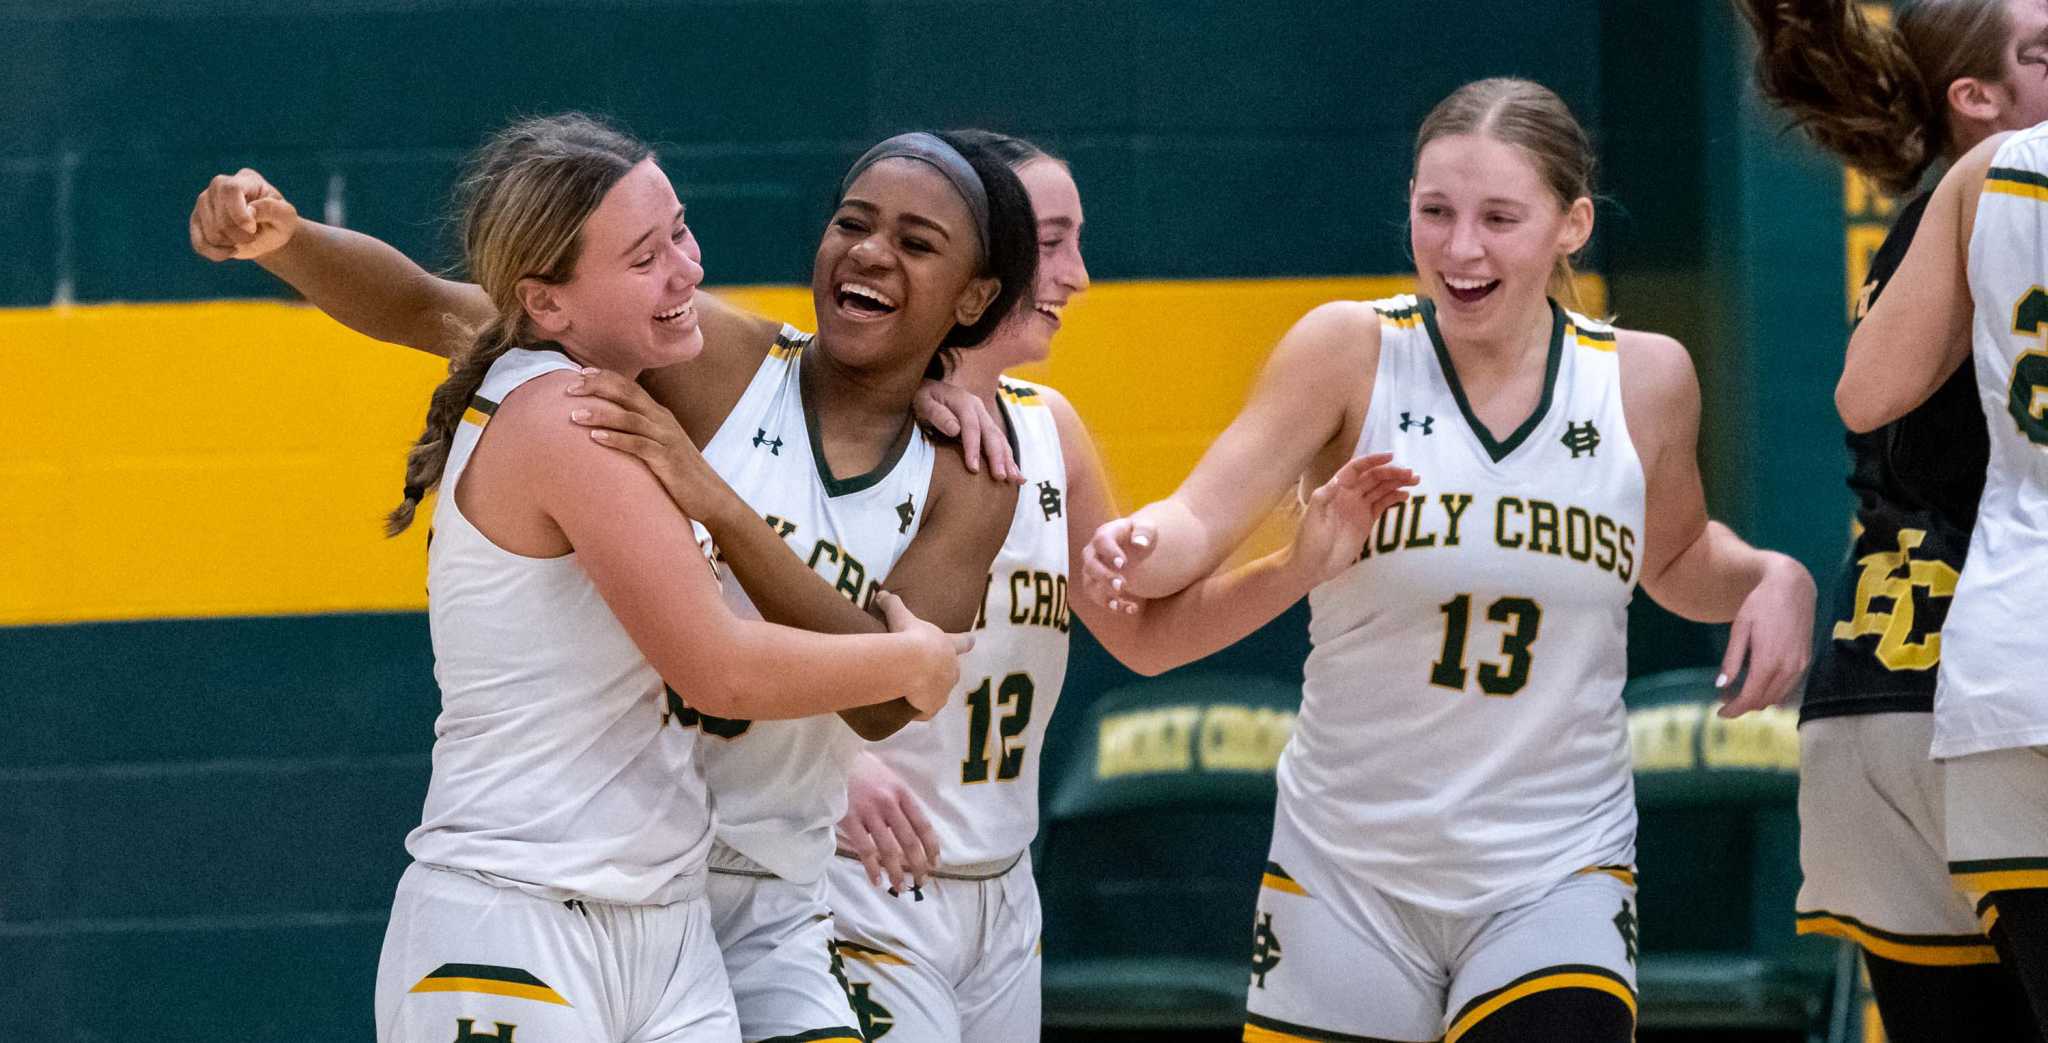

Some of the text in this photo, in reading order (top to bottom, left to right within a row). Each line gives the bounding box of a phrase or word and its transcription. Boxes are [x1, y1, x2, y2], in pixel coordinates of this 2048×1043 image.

[1494, 496, 1635, 584] CROSS
[1429, 592, 1543, 697] 13
[960, 672, 1035, 785] 12
